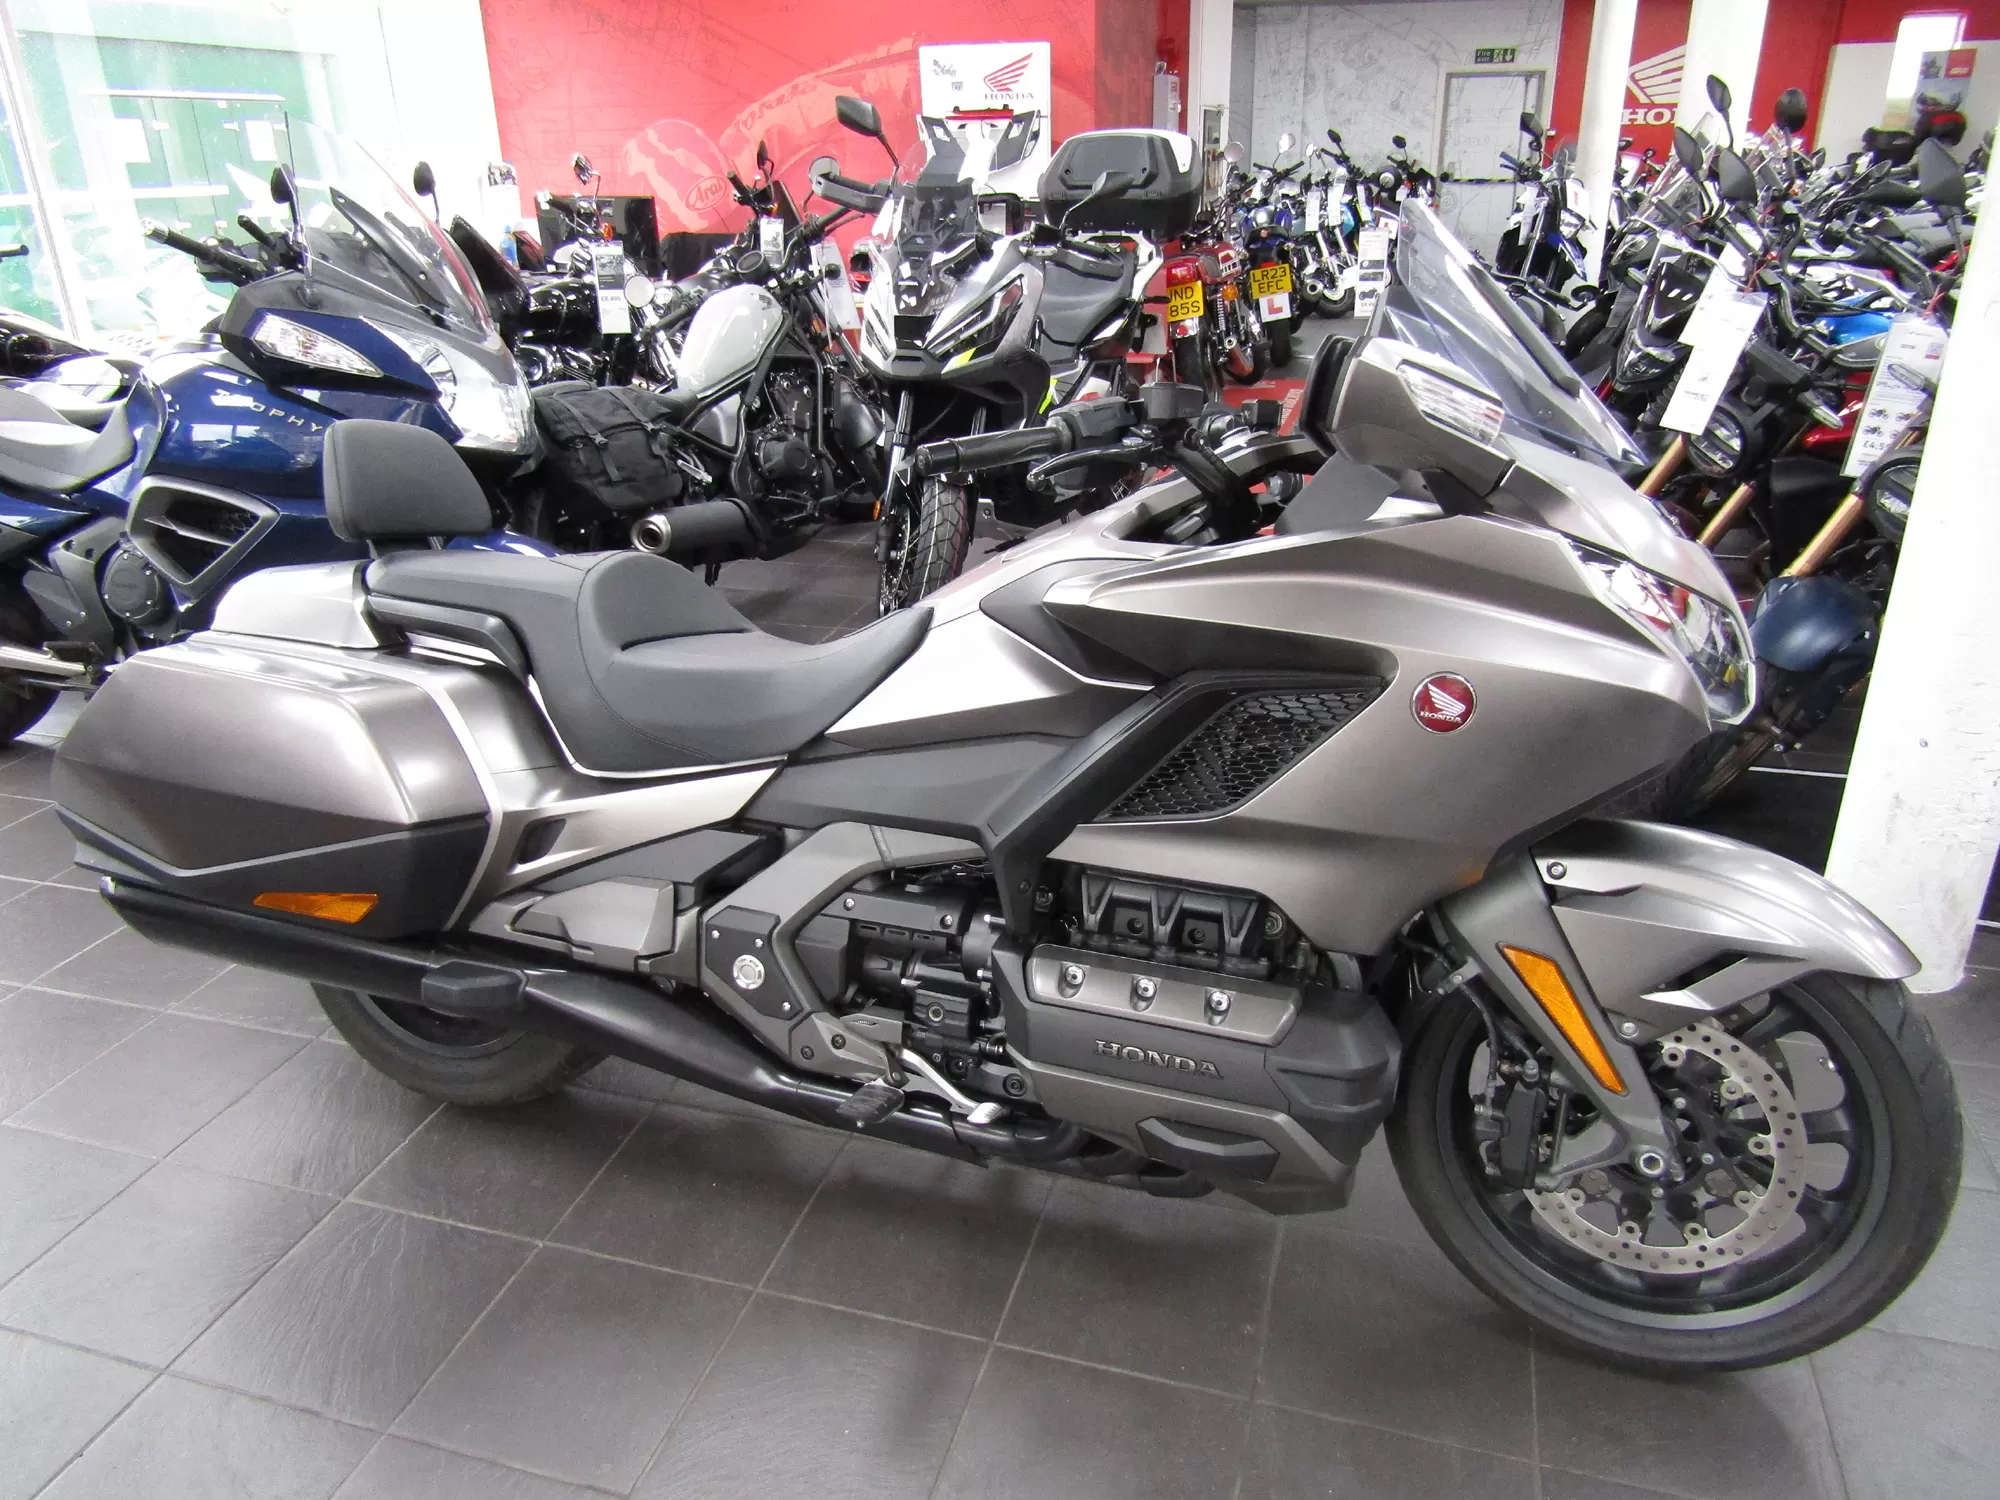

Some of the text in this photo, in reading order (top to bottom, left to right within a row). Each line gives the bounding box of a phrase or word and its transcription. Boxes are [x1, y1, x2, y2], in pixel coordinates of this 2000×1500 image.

[693, 178, 723, 206] Arai
[1252, 266, 1287, 283] LR23
[1258, 280, 1284, 294] EFC
[1170, 300, 1200, 317] 85S
[1267, 297, 1283, 315] L
[1419, 711, 1463, 723] HONDA
[1094, 1039, 1224, 1080] HONDA
